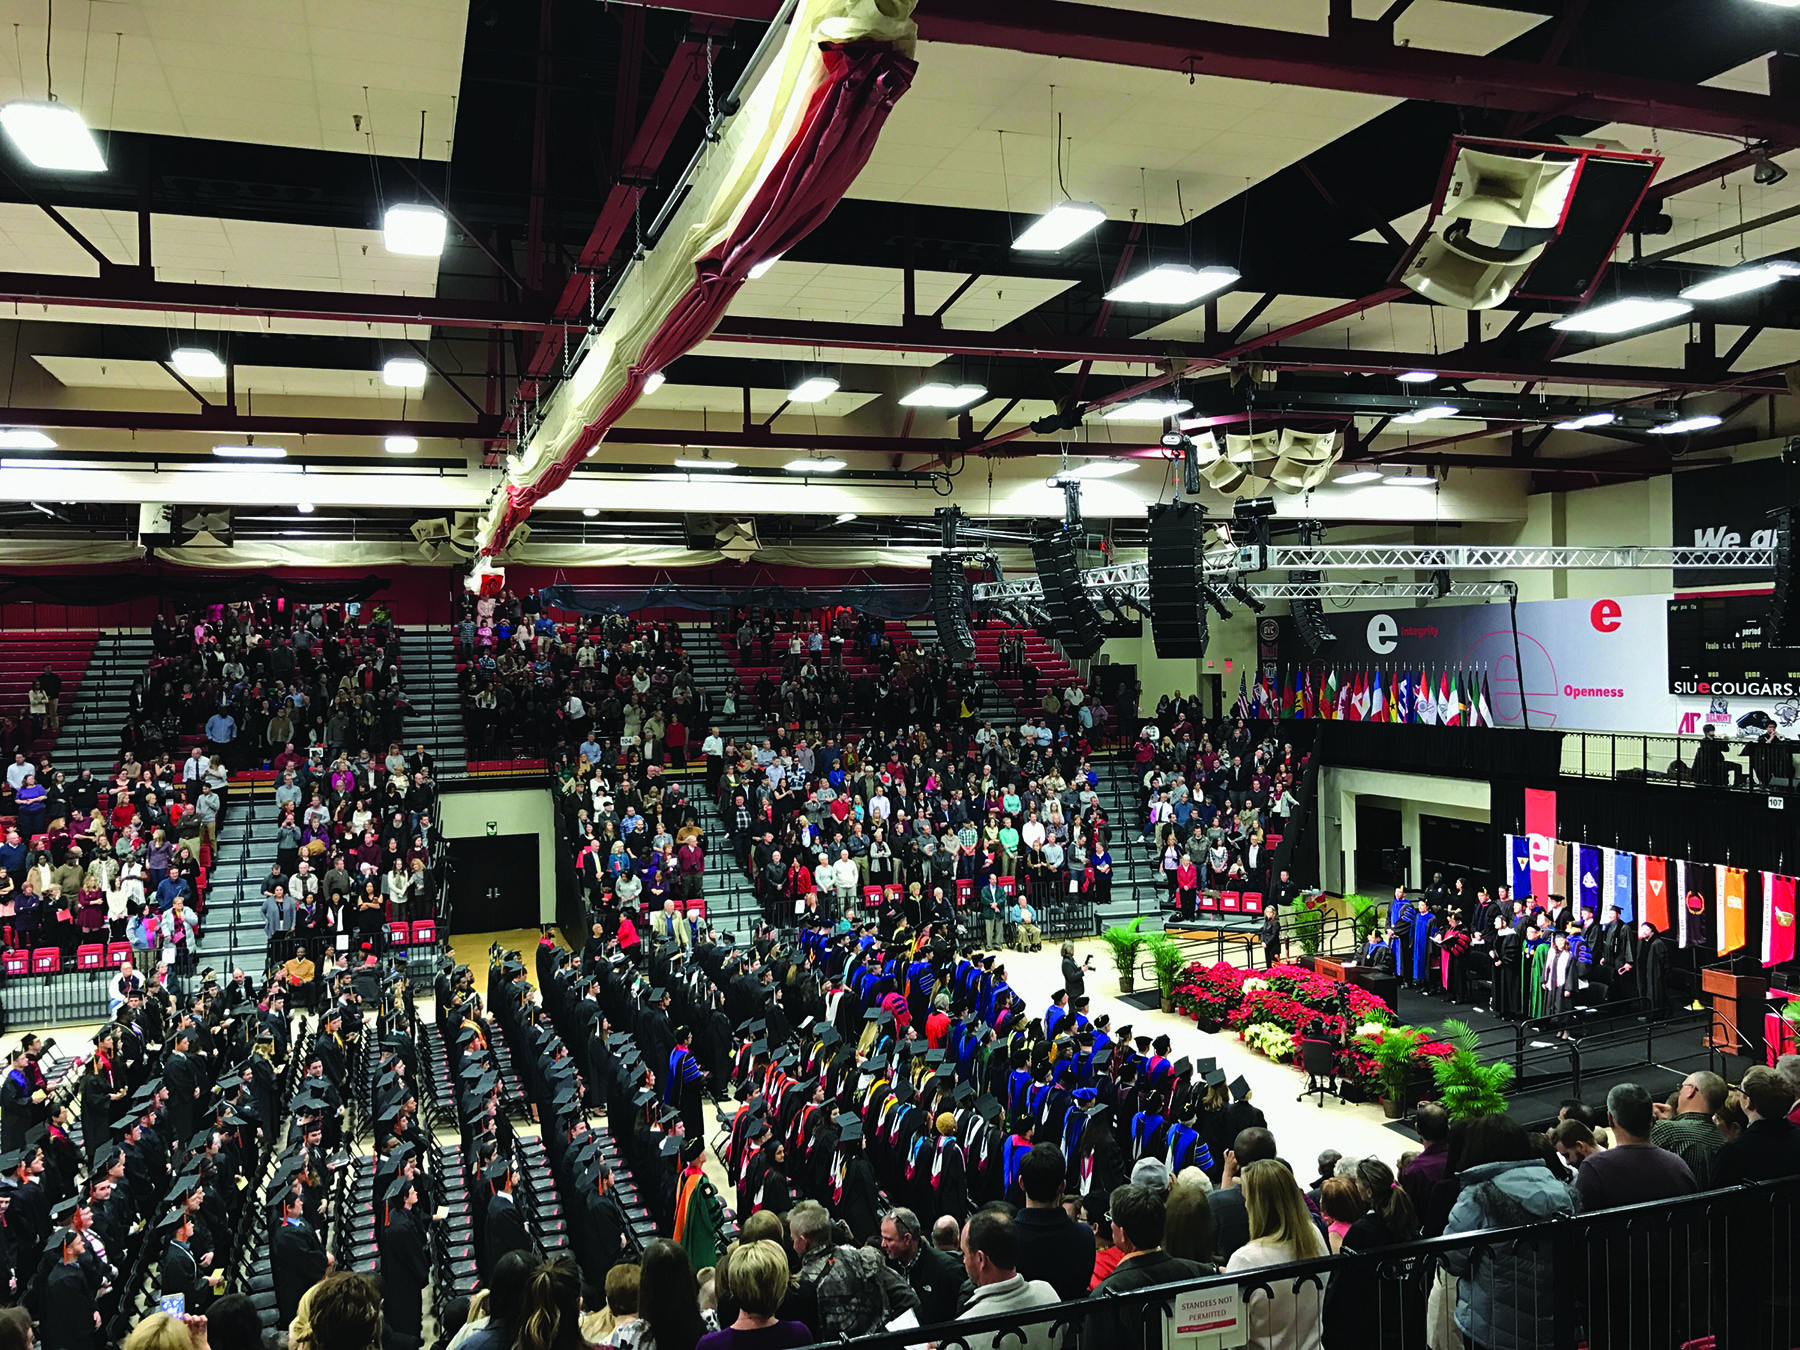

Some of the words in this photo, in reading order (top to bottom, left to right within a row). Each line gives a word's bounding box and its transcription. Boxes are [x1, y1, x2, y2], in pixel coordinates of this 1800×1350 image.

[1694, 526, 1741, 550] We
[1590, 599, 1622, 633] e
[1366, 613, 1398, 655] e
[1563, 684, 1624, 699] Openness
[1770, 799, 1782, 807] 107
[1181, 1299, 1217, 1310] STANDEES
[1218, 1296, 1233, 1305] NOT
[1189, 1309, 1226, 1320] PERMITTED
